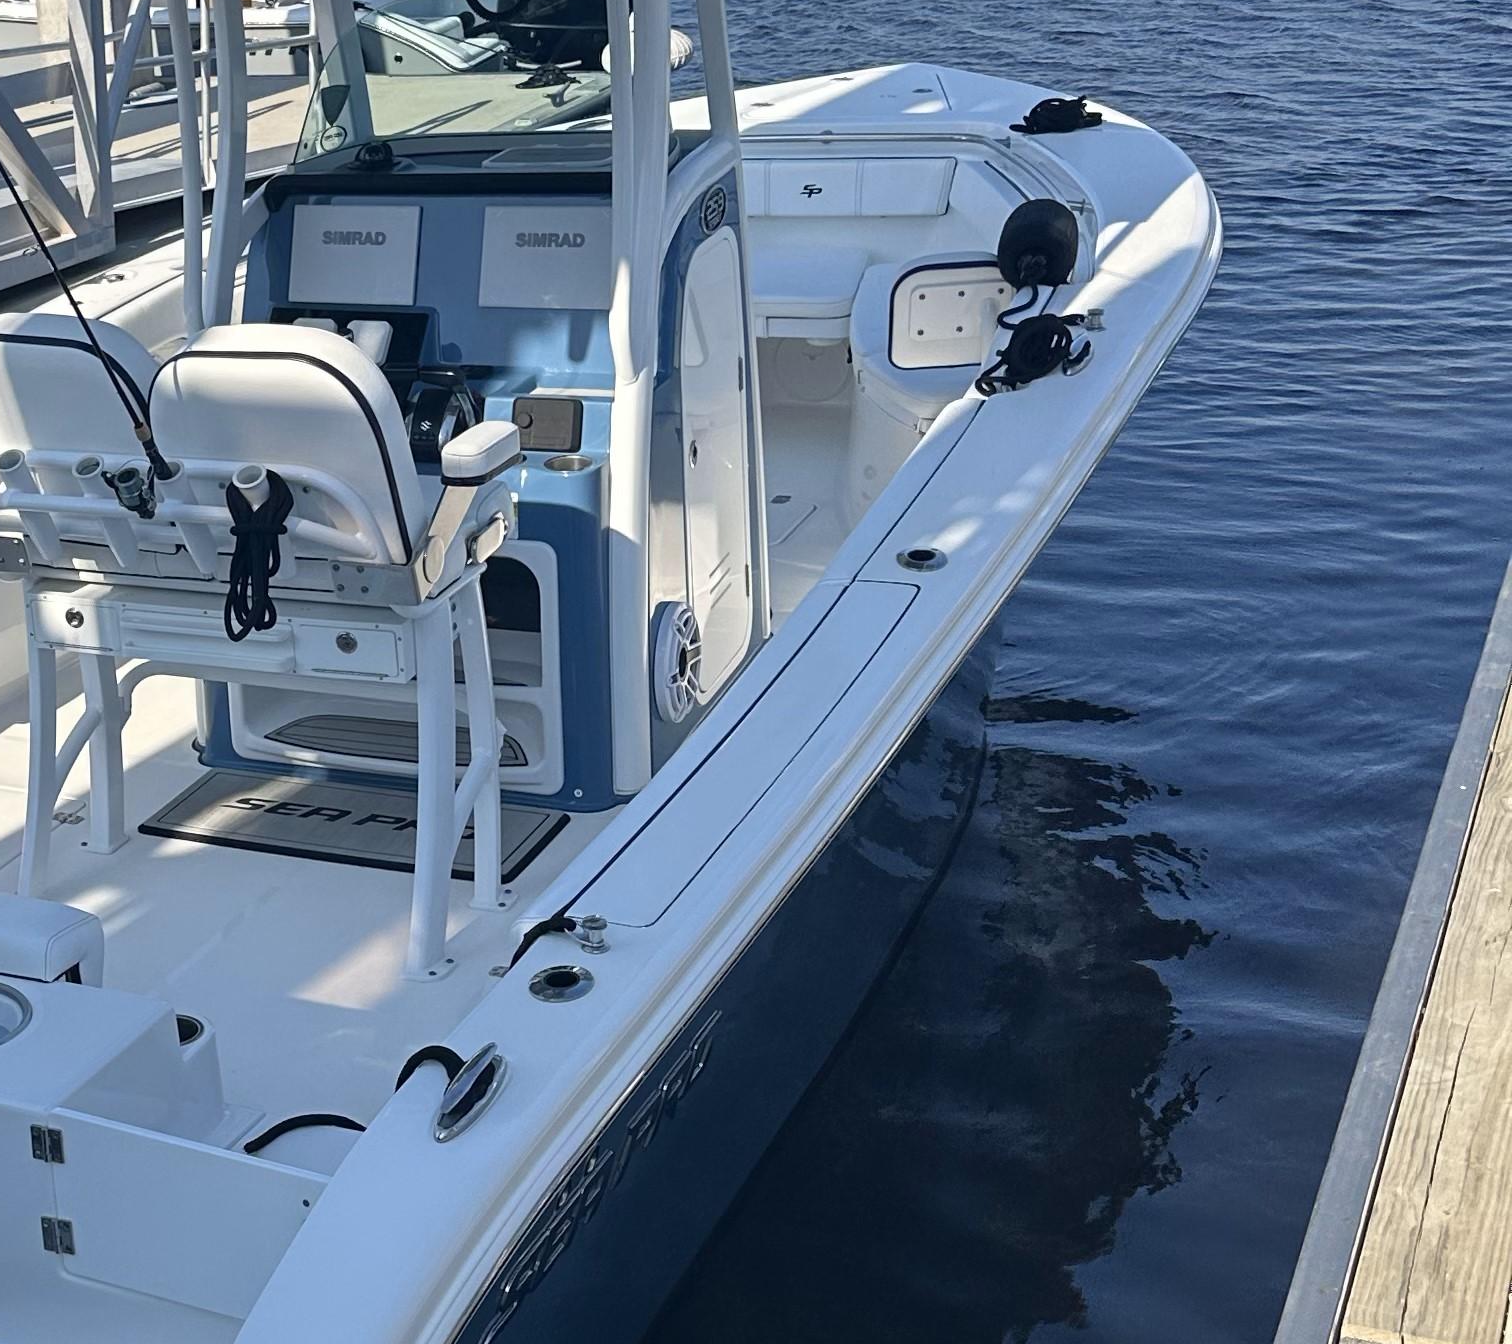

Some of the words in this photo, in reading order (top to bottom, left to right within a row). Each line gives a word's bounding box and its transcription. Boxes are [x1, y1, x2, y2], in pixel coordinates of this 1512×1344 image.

[322, 230, 387, 246] SIMRAD
[515, 232, 585, 248] SIMRAD
[220, 797, 352, 822] SEA
